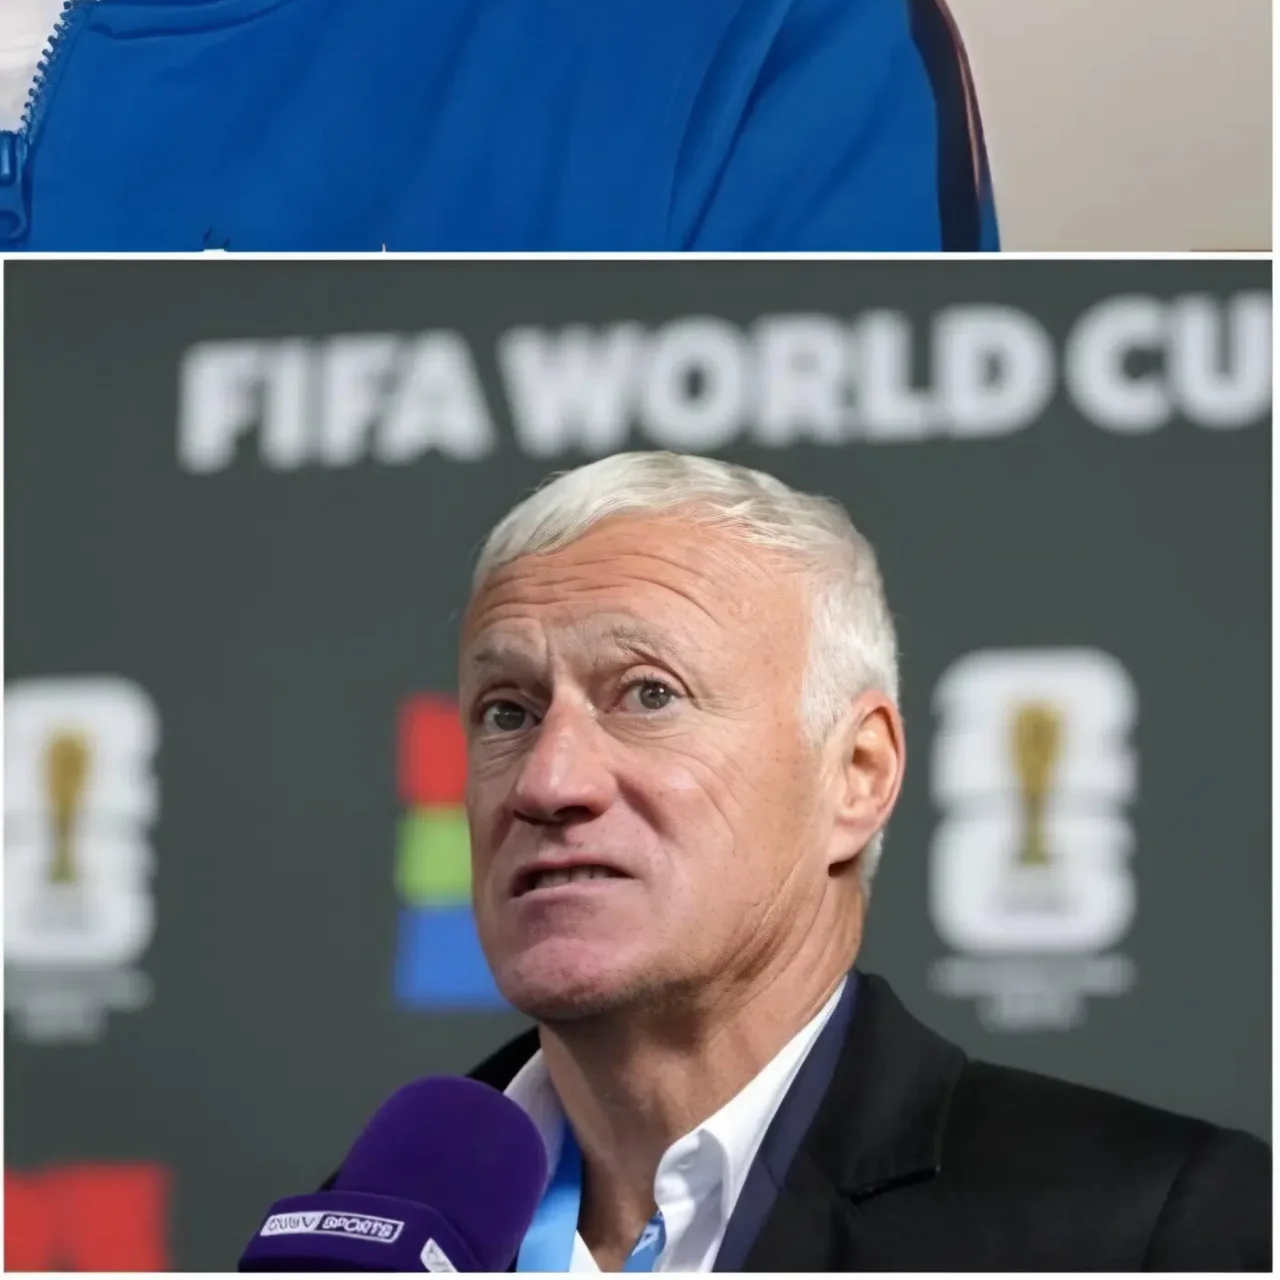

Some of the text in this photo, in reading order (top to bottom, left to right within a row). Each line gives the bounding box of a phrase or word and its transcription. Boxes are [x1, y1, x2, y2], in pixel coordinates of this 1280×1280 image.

[178, 290, 1272, 474] FIFA WORLD CU
